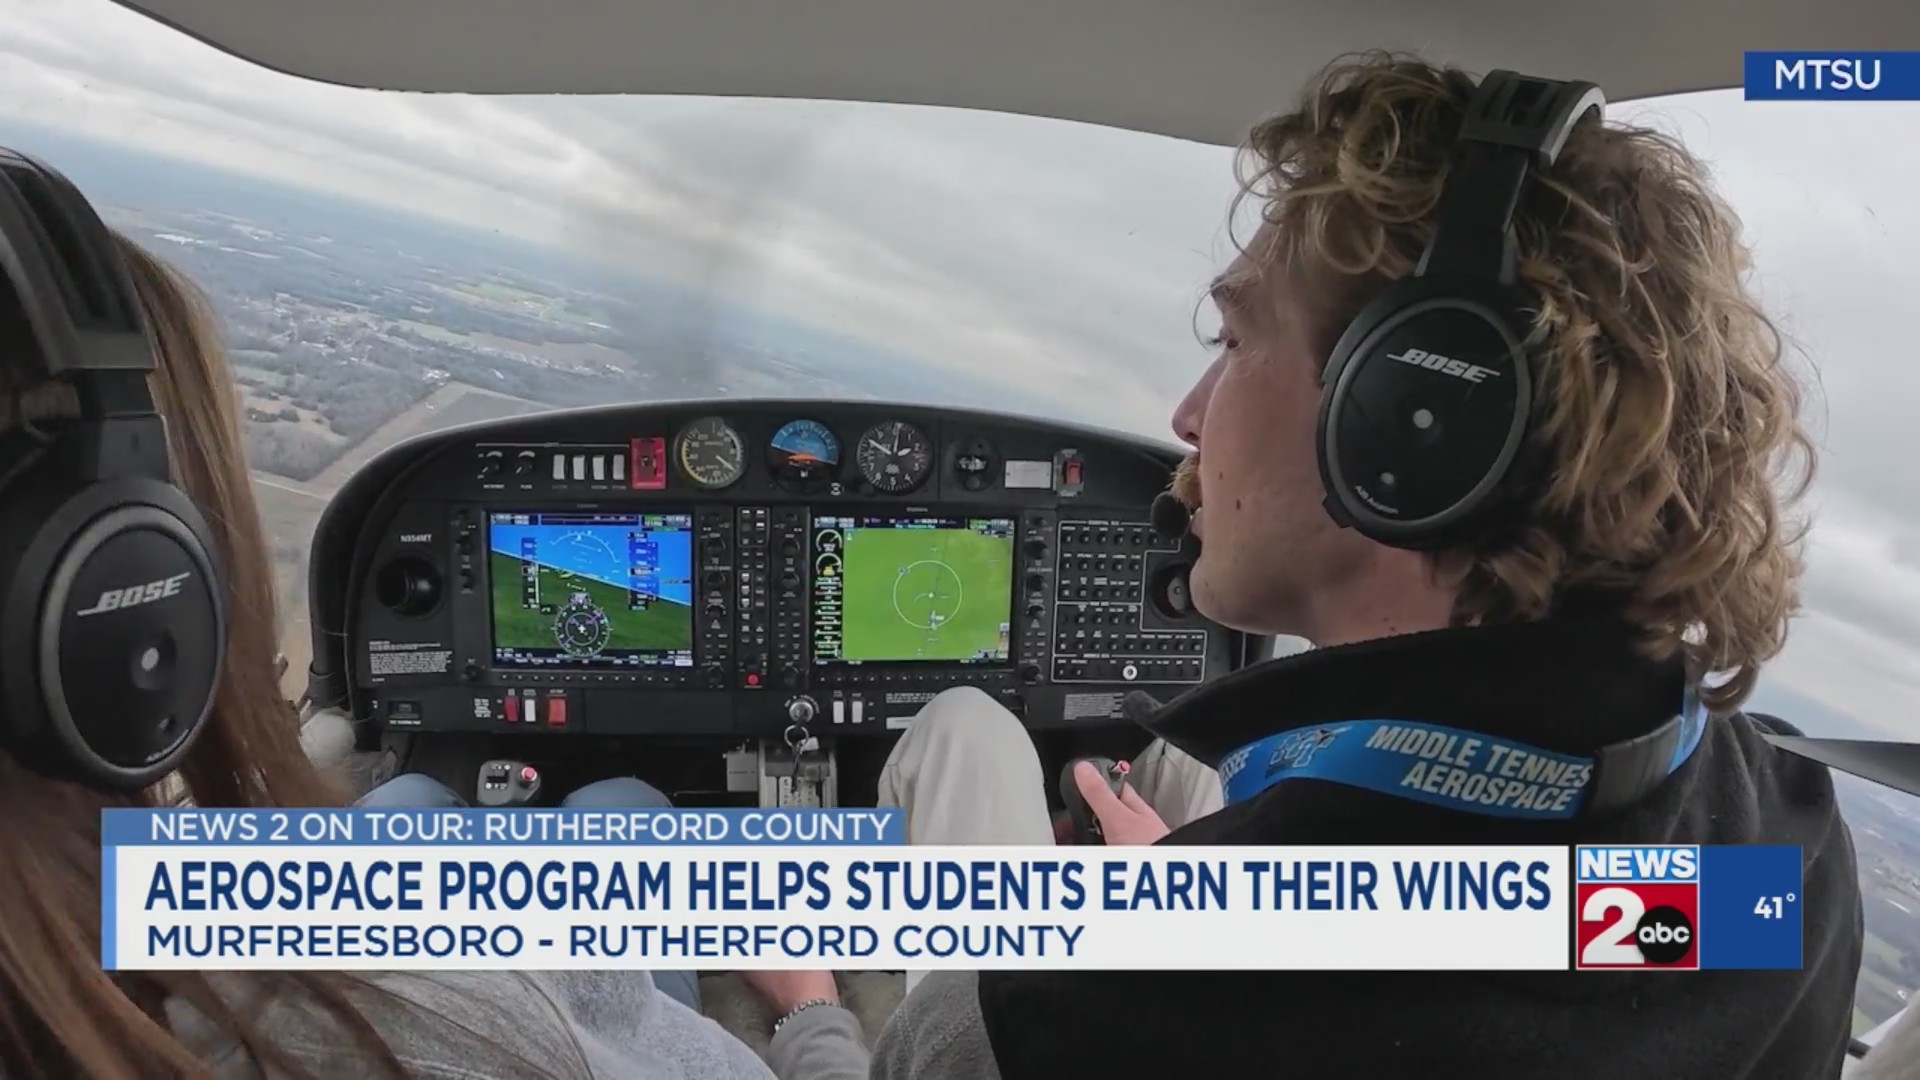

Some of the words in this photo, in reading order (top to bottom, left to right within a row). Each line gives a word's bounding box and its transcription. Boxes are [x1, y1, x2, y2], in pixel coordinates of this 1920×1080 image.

[1386, 348, 1501, 383] BOSE
[76, 571, 191, 617] BOSE
[1365, 725, 1483, 768] MIDDLE
[1400, 761, 1579, 812] AEROSPACE
